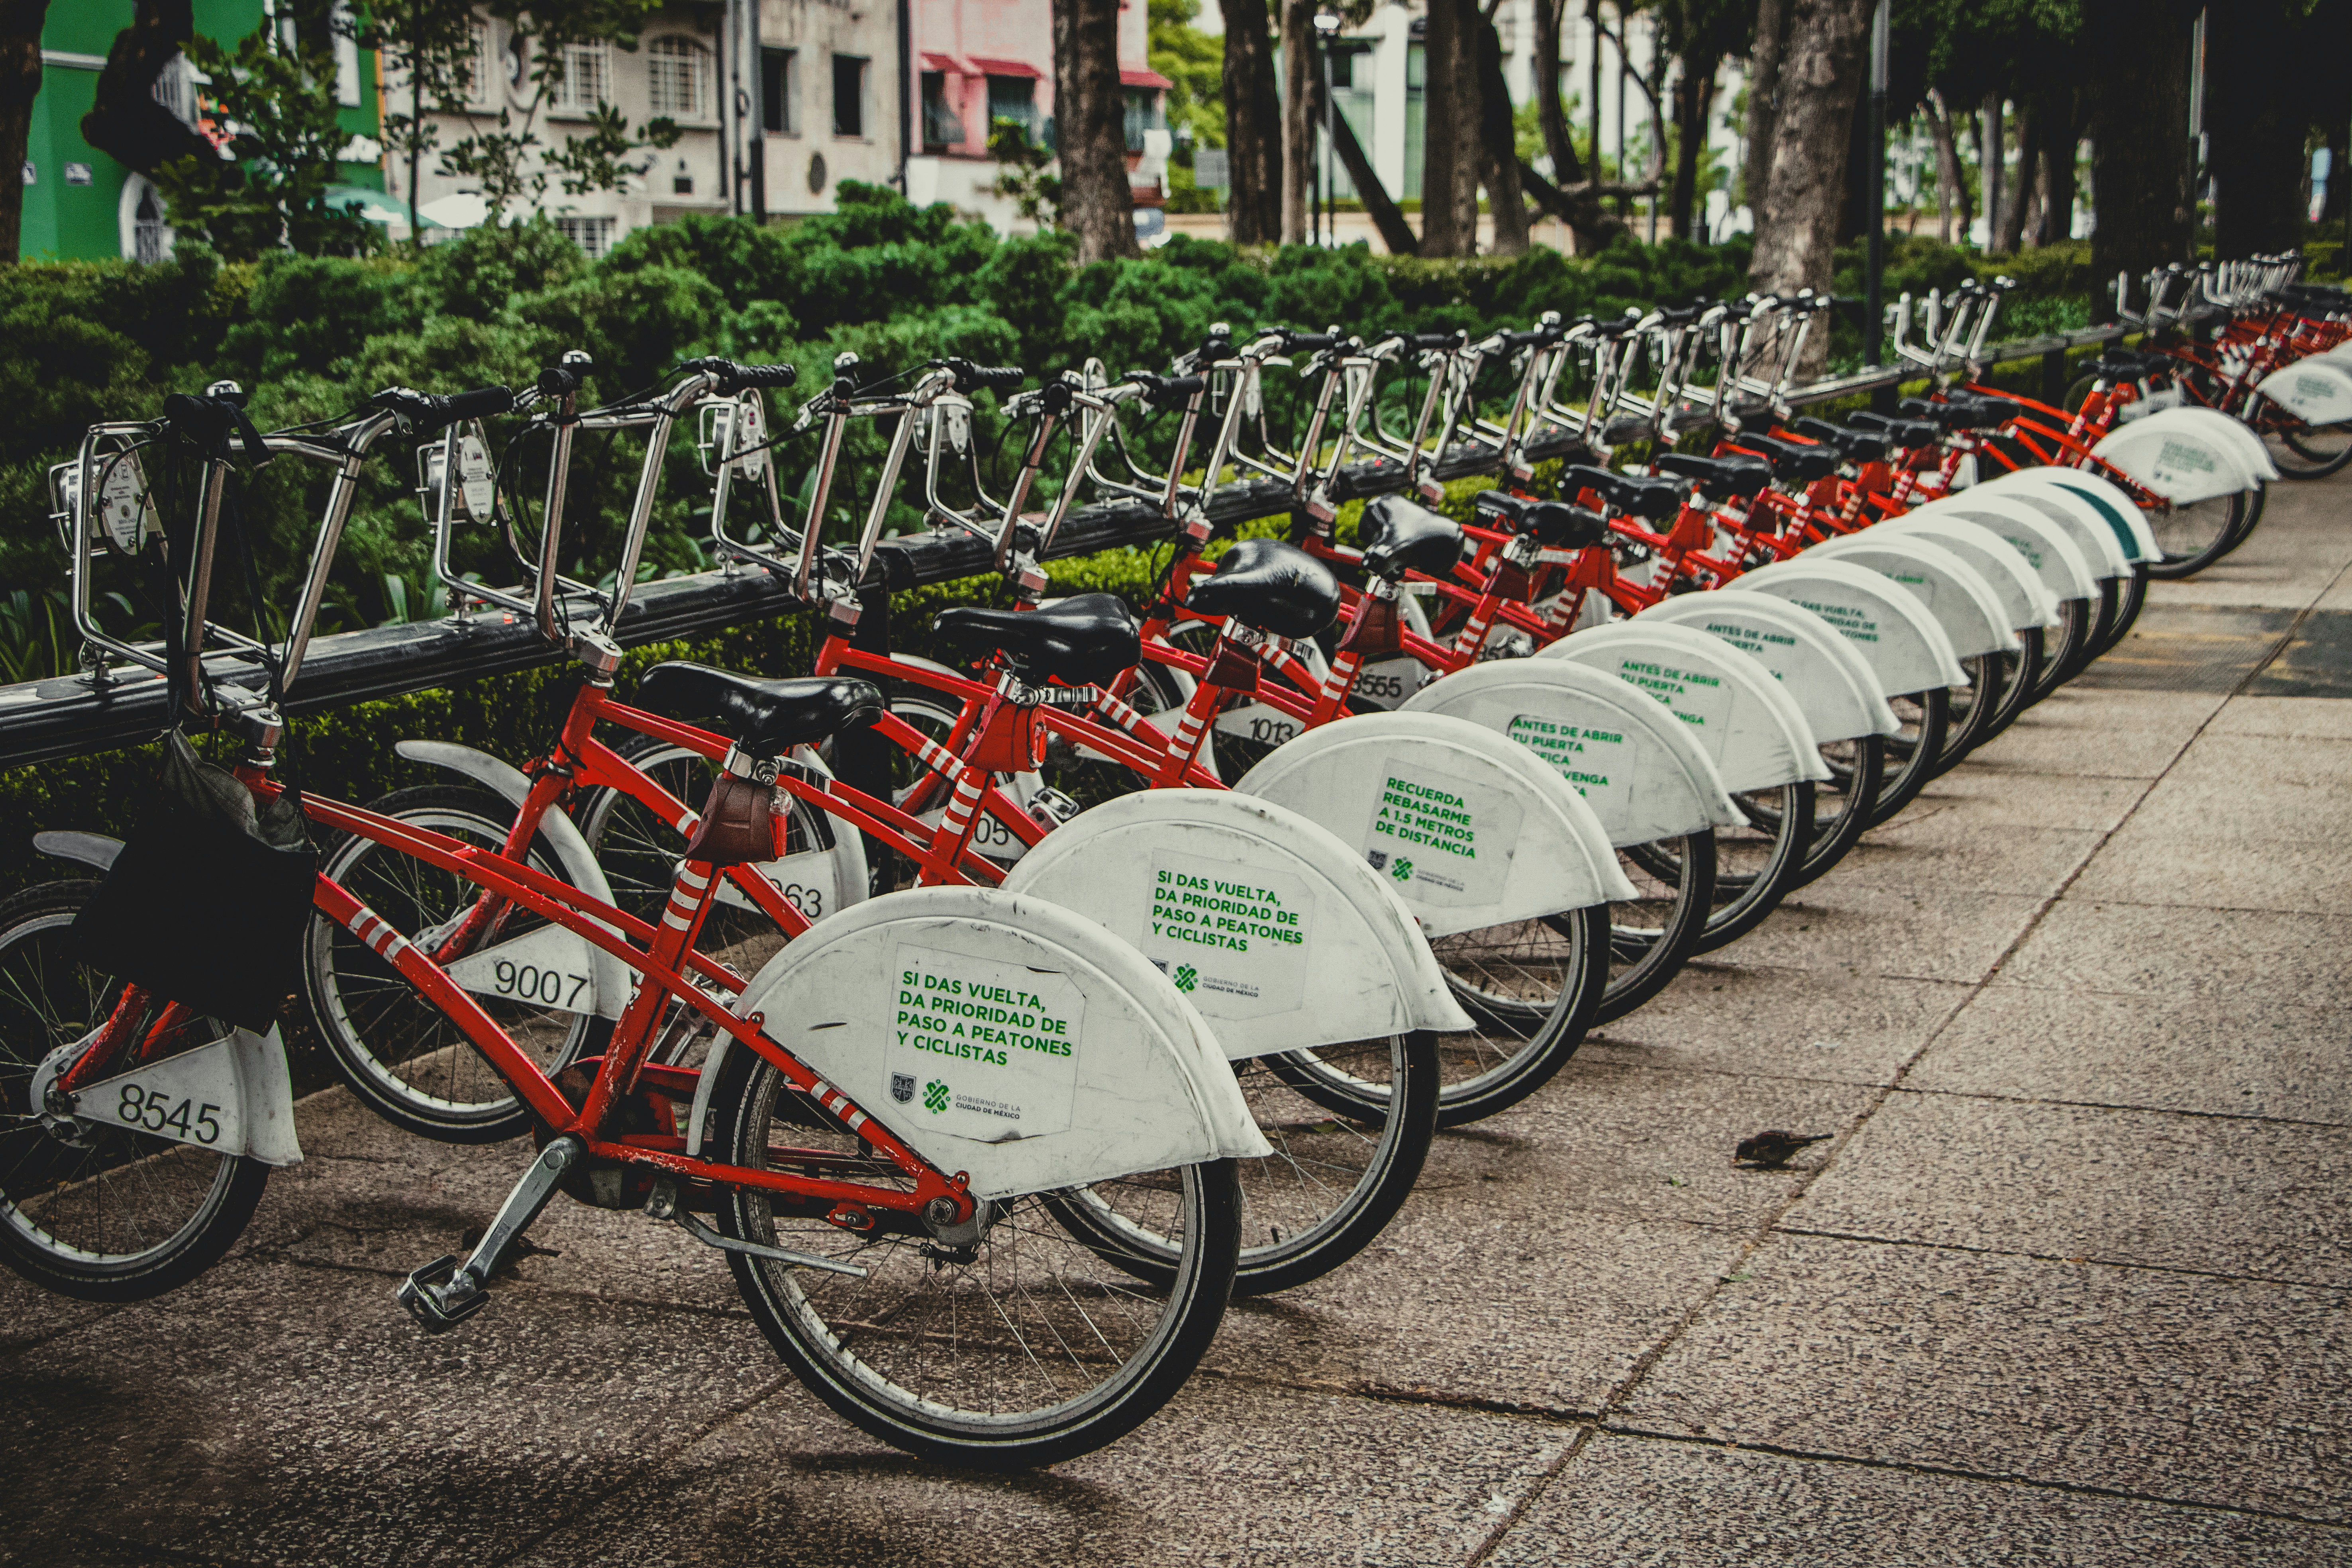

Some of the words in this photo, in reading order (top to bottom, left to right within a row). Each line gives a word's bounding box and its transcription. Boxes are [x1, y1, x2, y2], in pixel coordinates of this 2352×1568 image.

[1706, 623, 1742, 637] ANTES
[1744, 629, 1760, 639] DE
[1622, 660, 1661, 676] ANTES
[1663, 667, 1681, 680] DE
[1682, 673, 1720, 688] ABRIR
[1638, 677, 1685, 694] PUERTA
[1513, 733, 1530, 745] TU
[1532, 736, 1584, 753] PUERTA
[1514, 717, 1557, 734] ANTES
[1560, 725, 1579, 738] DE
[1582, 729, 1623, 744] ABRIR
[1387, 777, 1464, 809] RECUERDA
[1563, 770, 1609, 786] VENGA
[1379, 807, 1390, 819] A
[1394, 810, 1413, 825] 1.5
[1415, 817, 1475, 843] METROS
[1383, 792, 1472, 826] REBASARME
[1375, 821, 1396, 835] DE
[1399, 827, 1476, 860] DISTANCIA
[1157, 870, 1172, 884] SI
[1176, 874, 1209, 892] DAS
[1214, 880, 1281, 907] VUELTA,
[1155, 887, 1177, 903] DA
[1182, 892, 1272, 921] PRIORIDAD
[1276, 911, 1299, 927] DE
[1152, 905, 1197, 925] PASO
[1200, 914, 1212, 928] A
[1216, 917, 1303, 945] PEATONES
[1152, 922, 1163, 936] Y
[1166, 925, 1248, 952] CICLISTAS
[495, 960, 588, 1007] 9007
[902, 971, 919, 987] SI
[924, 975, 962, 995] DAS
[968, 983, 1046, 1013] VUELTA,
[899, 991, 926, 1009] DA
[931, 997, 1036, 1029] PRIORIDAD
[1041, 1017, 1067, 1036] DE
[896, 1032, 908, 1046] Y
[913, 1035, 1008, 1066] CICLISTAS
[897, 1011, 947, 1033] PASO
[951, 1023, 965, 1038] A
[971, 1025, 1072, 1057] PEATONES
[118, 1083, 221, 1144] 8545
[956, 1094, 996, 1107] GOBIERNO
[956, 1102, 981, 1111] CIUDAD
[994, 1109, 1020, 1119] MÉXICO
